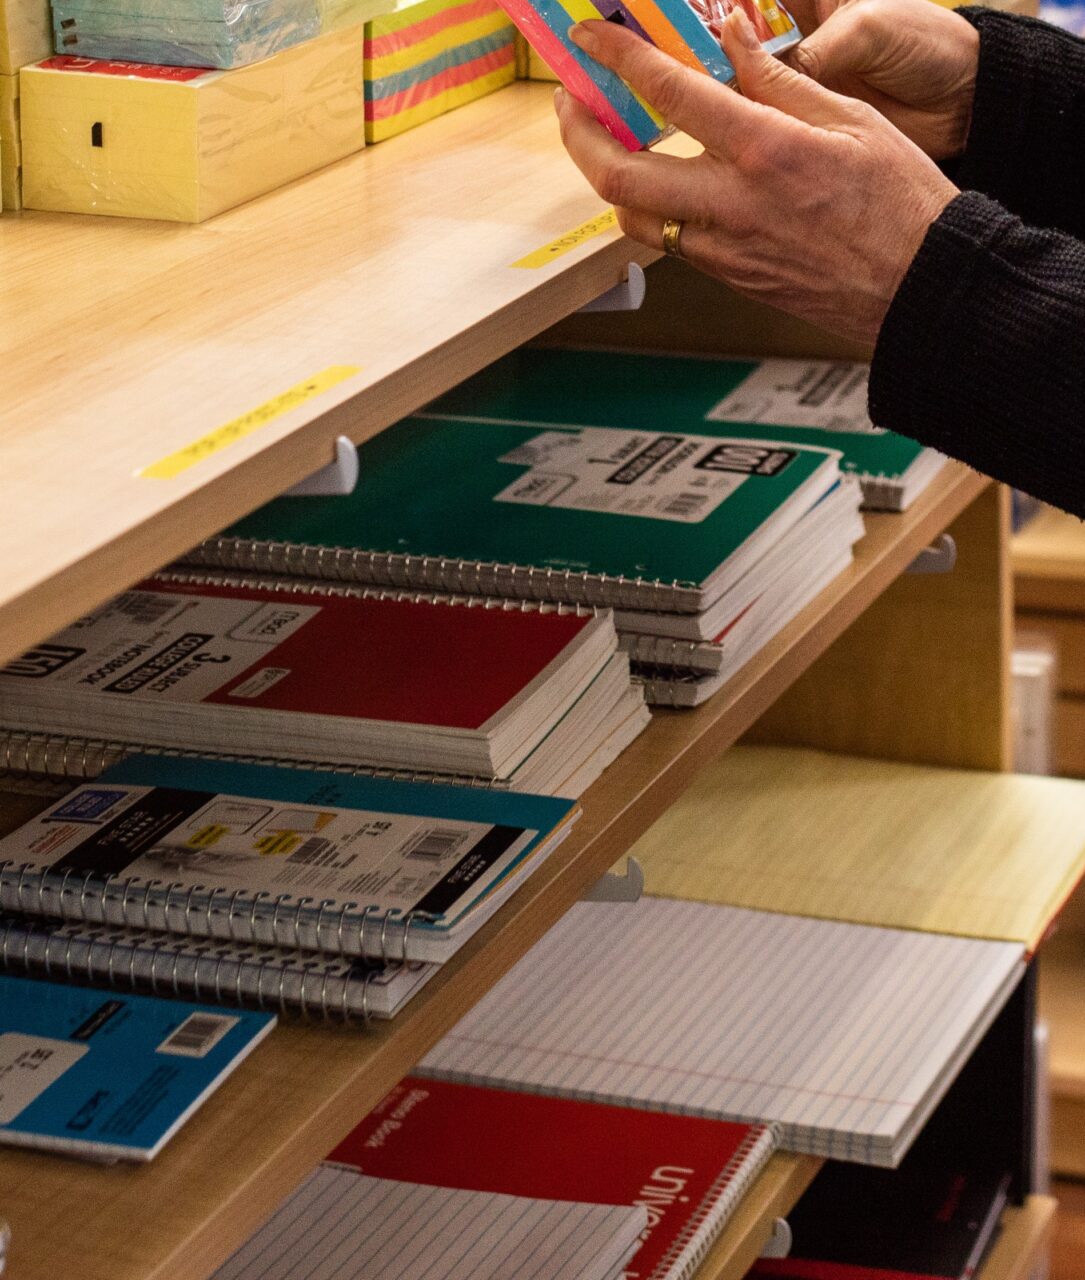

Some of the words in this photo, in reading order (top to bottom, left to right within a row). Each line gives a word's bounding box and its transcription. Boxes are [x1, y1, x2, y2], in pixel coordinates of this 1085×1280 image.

[705, 446, 768, 472] 100
[7, 647, 74, 676] 150
[80, 643, 151, 685] NOTEBOOK
[156, 635, 206, 669] COLLEGE
[194, 651, 231, 664] 3
[116, 663, 162, 690] RULED
[147, 661, 201, 694] SUBJECT
